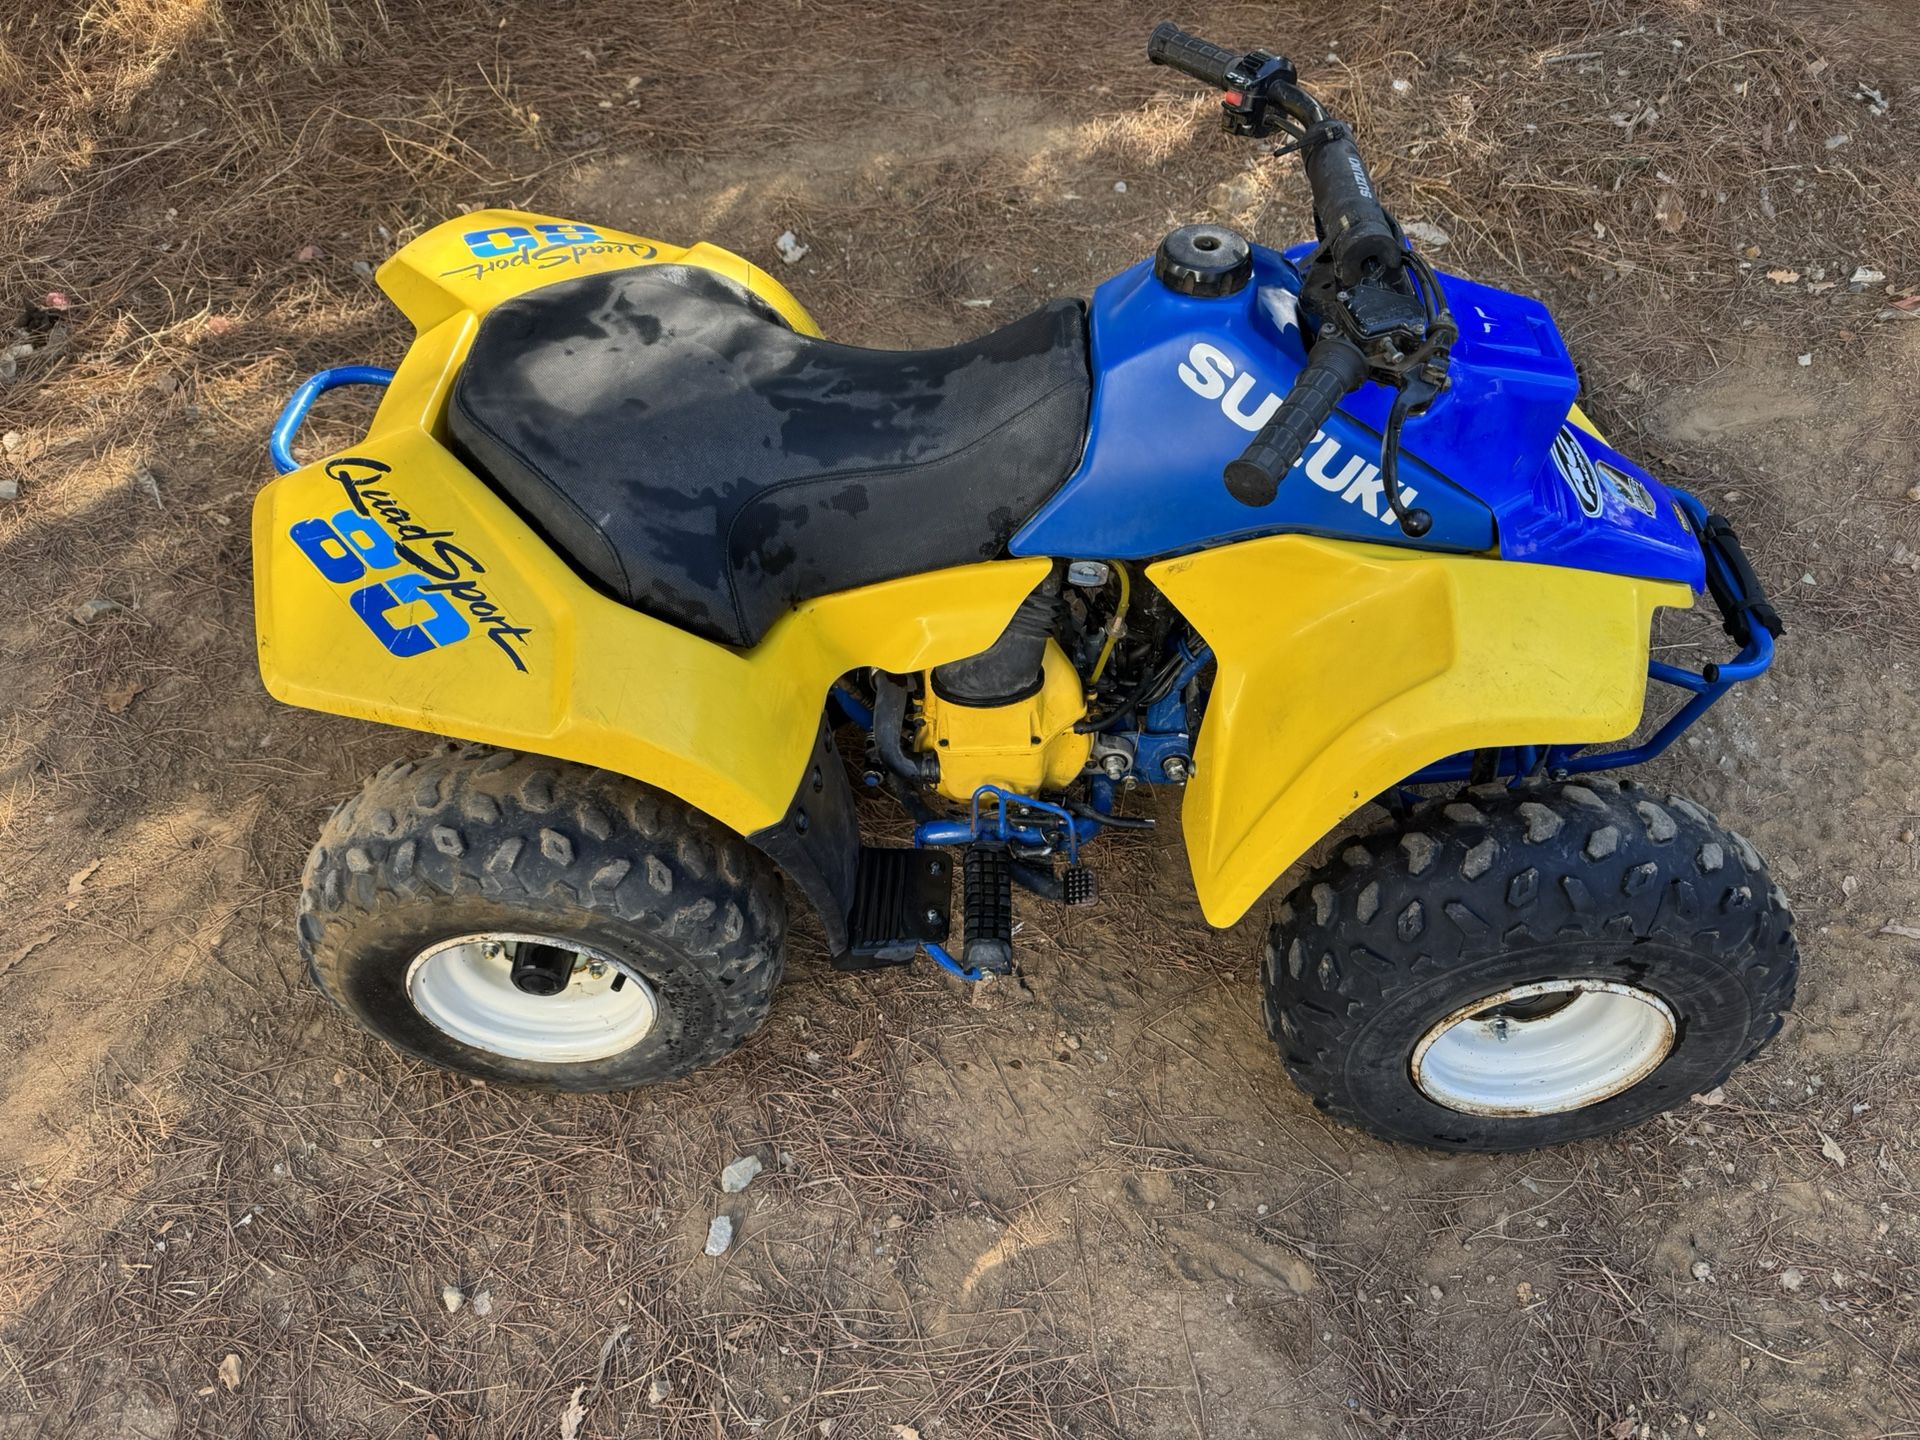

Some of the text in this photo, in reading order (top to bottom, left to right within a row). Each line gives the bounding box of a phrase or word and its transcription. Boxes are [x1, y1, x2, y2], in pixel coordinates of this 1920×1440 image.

[1347, 157, 1373, 199] SUZUKI
[463, 224, 605, 258] 80
[1177, 342, 1419, 526] SUUKI
[289, 508, 470, 658] 80
